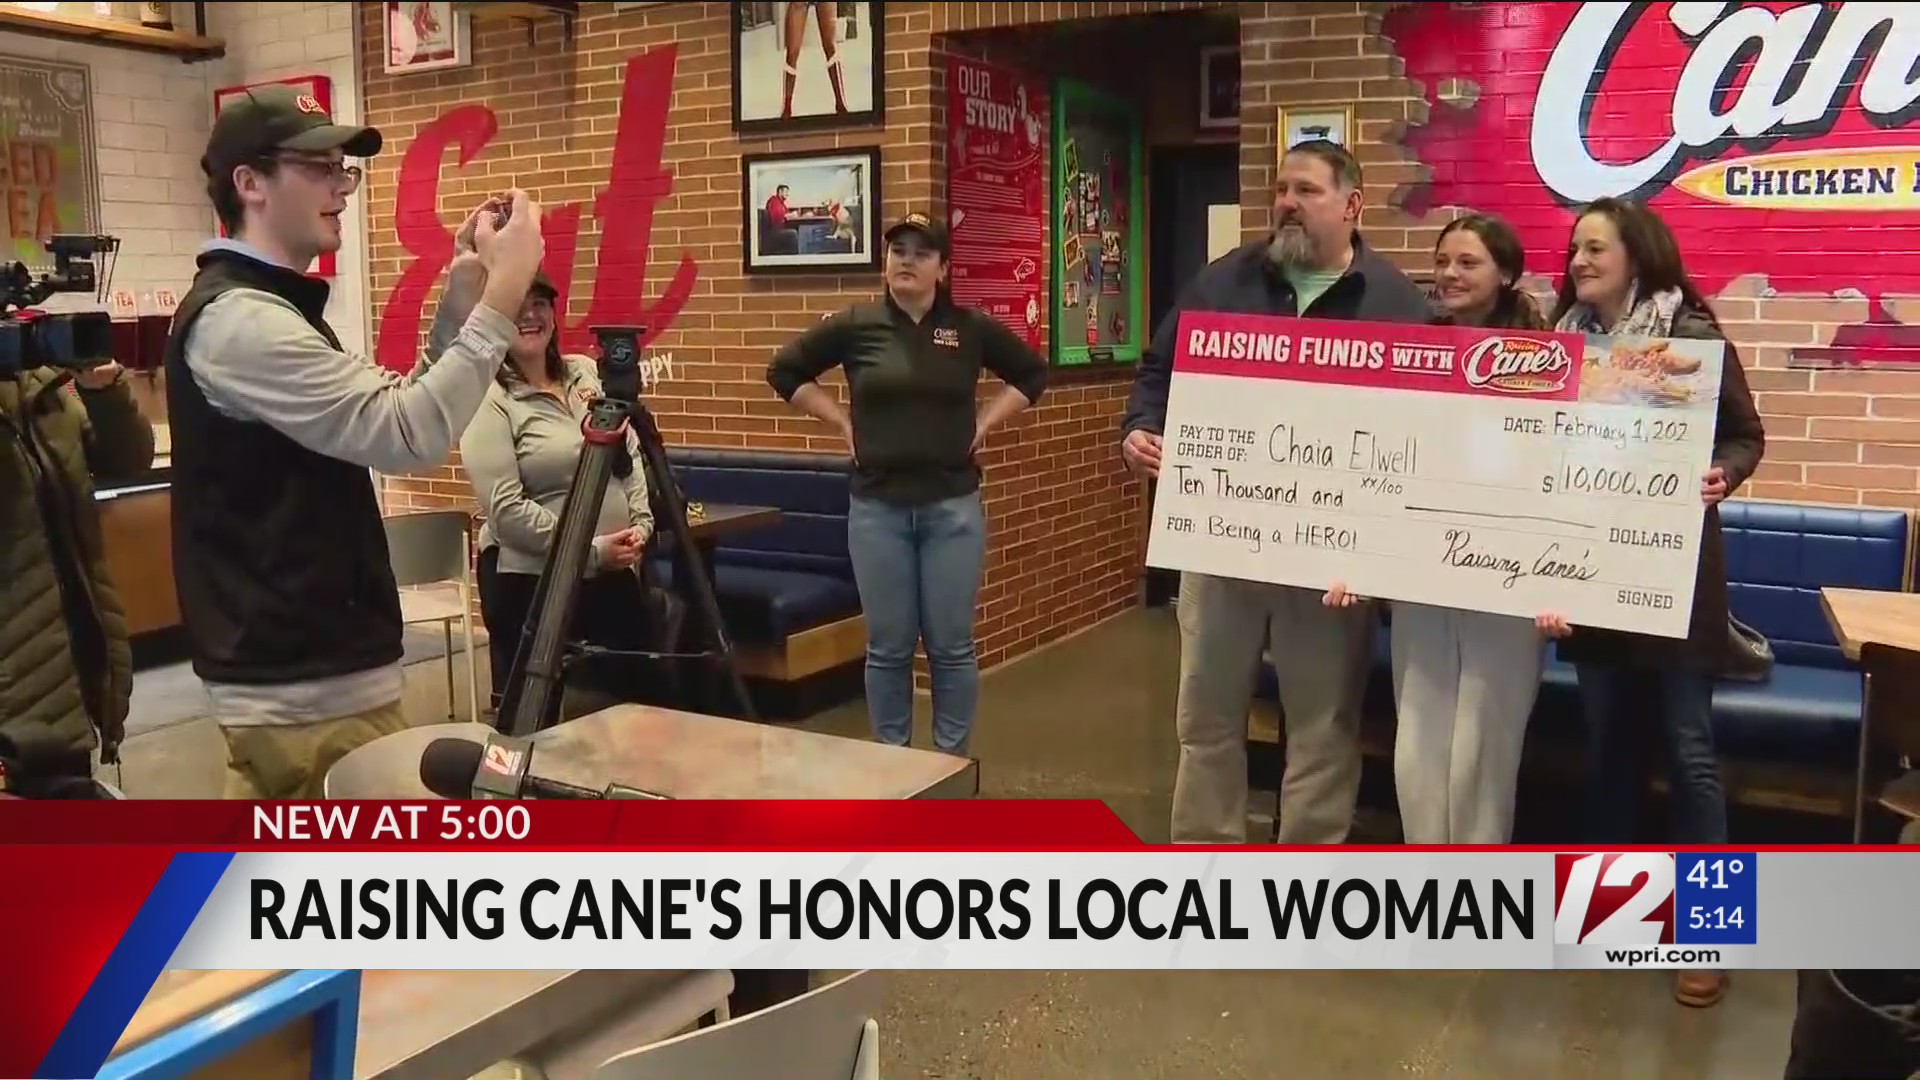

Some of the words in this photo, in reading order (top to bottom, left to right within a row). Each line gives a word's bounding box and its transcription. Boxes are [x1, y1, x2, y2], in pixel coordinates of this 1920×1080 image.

[959, 66, 991, 99] OUR
[966, 98, 1016, 134] STORY
[1725, 166, 1895, 196] CHICKEN
[1189, 329, 1291, 363] RAISING
[1298, 337, 1386, 370] FUNDS
[1391, 347, 1456, 370] WITH
[1467, 336, 1568, 385] Cane's
[1180, 424, 1204, 440] PAY
[1207, 427, 1224, 442] TO
[1229, 429, 1256, 445] THE
[1503, 416, 1546, 434] DATE:
[1554, 411, 1627, 449] February
[1177, 442, 1223, 460] ORDER
[1228, 447, 1248, 463] OF:
[1268, 423, 1334, 467] Chaia
[1349, 430, 1418, 475] Elwell
[1173, 465, 1205, 496] Ten
[1212, 467, 1299, 505] Thousand
[1312, 490, 1344, 508] and
[1542, 475, 1554, 494] $
[1565, 464, 1680, 498] 10,000.00
[1167, 516, 1196, 534] FOR:
[1208, 515, 1261, 553] Being
[1272, 531, 1282, 544] a
[1295, 522, 1358, 550] HERO!
[1608, 528, 1684, 550] DOLLARS
[1441, 529, 1527, 589] Raising
[1532, 542, 1600, 581] Cane's
[1617, 590, 1674, 611] SIGNED
